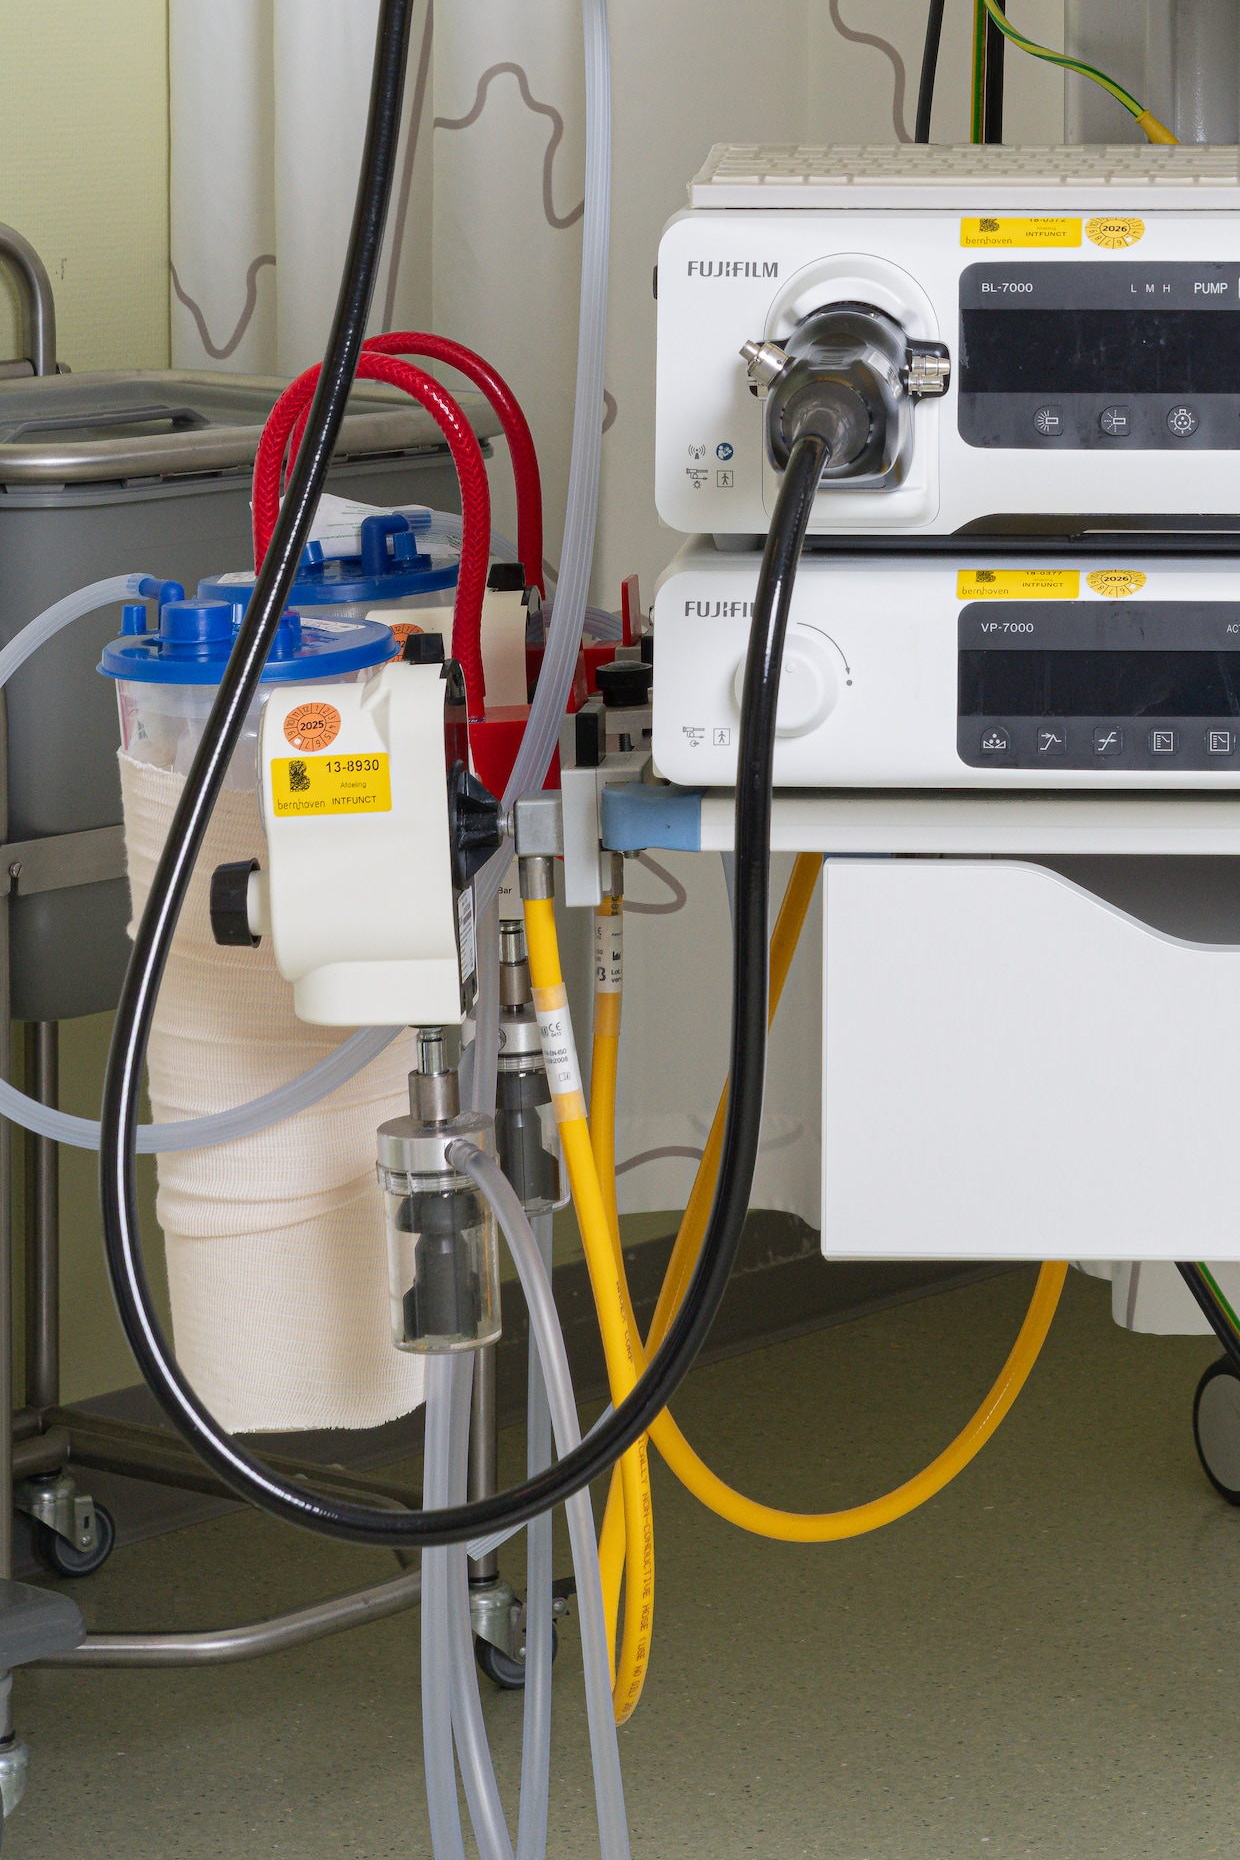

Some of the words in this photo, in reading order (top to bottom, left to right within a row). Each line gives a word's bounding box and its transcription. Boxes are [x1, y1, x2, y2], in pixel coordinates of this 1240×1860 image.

[1102, 224, 1128, 232] 2026
[965, 236, 1013, 245] bernhoven
[687, 260, 779, 278] FUJIFILM
[981, 282, 1033, 293] BL-7000
[1130, 283, 1137, 293] L
[1145, 283, 1155, 293] M
[1162, 283, 1171, 293] H
[1194, 282, 1228, 294] PUMP
[961, 586, 1009, 595] bernhoven
[981, 622, 1034, 634] VP-7000
[300, 720, 325, 731] 2025
[325, 759, 380, 774] 13-8930
[277, 798, 326, 811] bernhoven
[331, 795, 377, 806] INTFUNCT
[640, 1604, 650, 1631] HOSE
